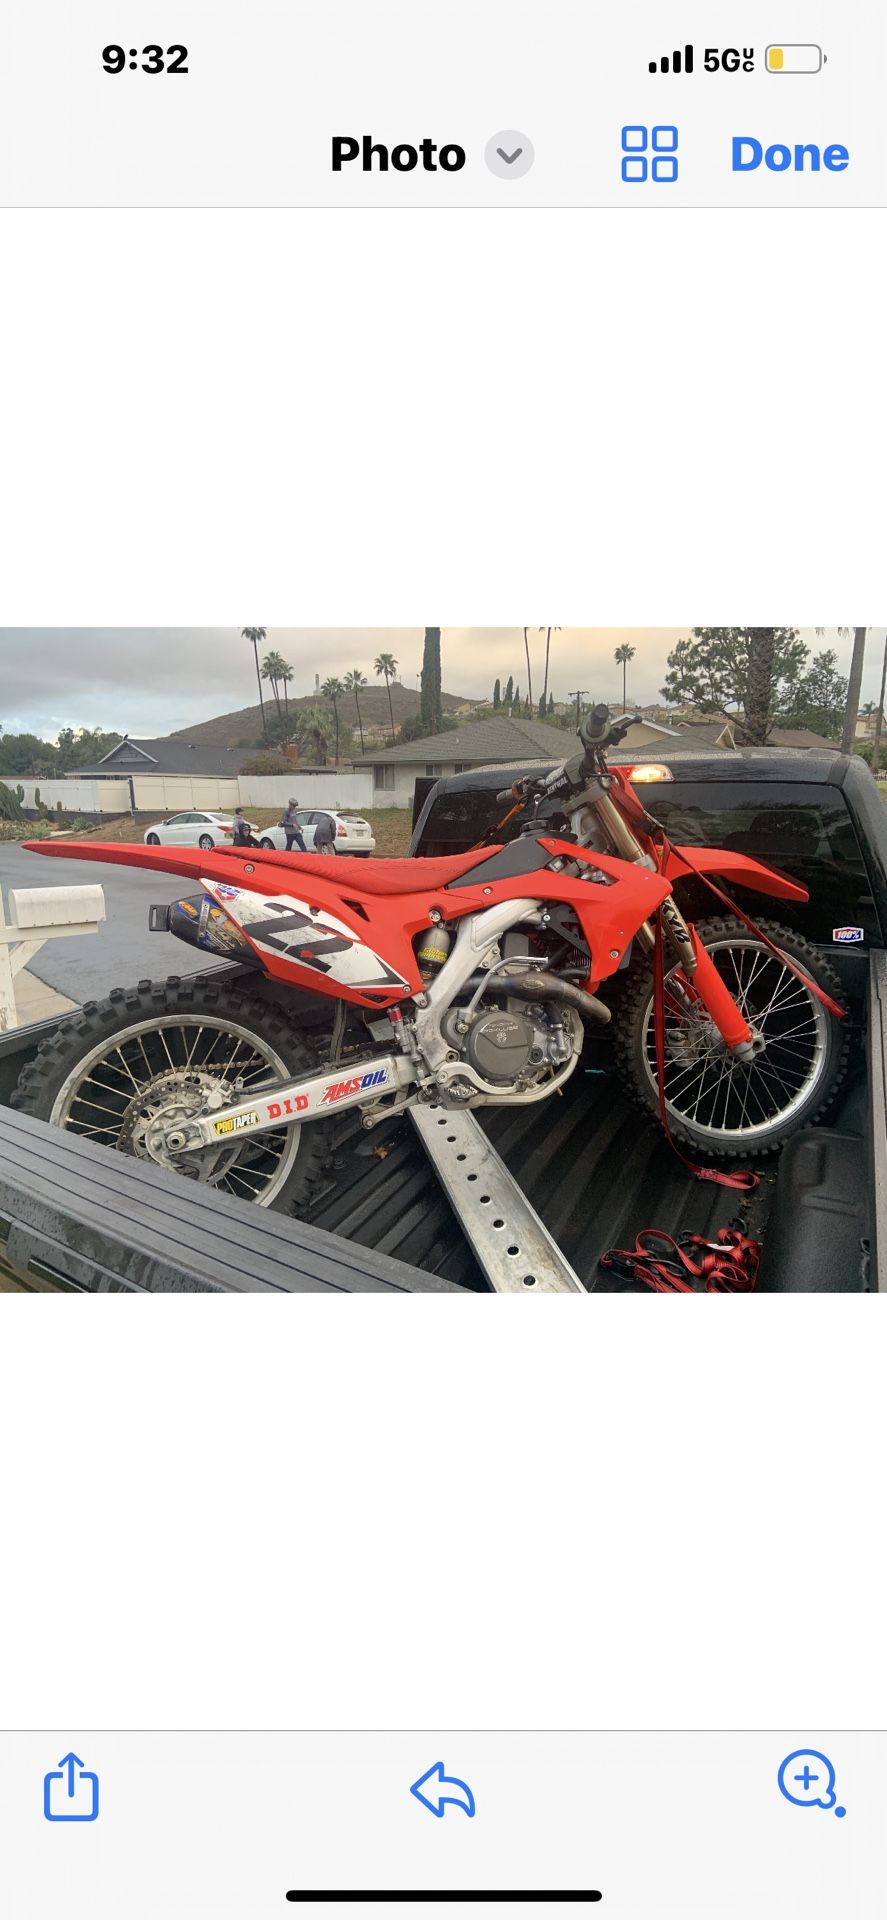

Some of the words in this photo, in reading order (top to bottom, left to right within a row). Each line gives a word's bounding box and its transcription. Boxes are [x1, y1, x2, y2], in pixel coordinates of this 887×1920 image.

[837, 930, 860, 939] 100%
[319, 1069, 387, 1104] AMSOIL
[216, 1112, 256, 1134] PROTAPER
